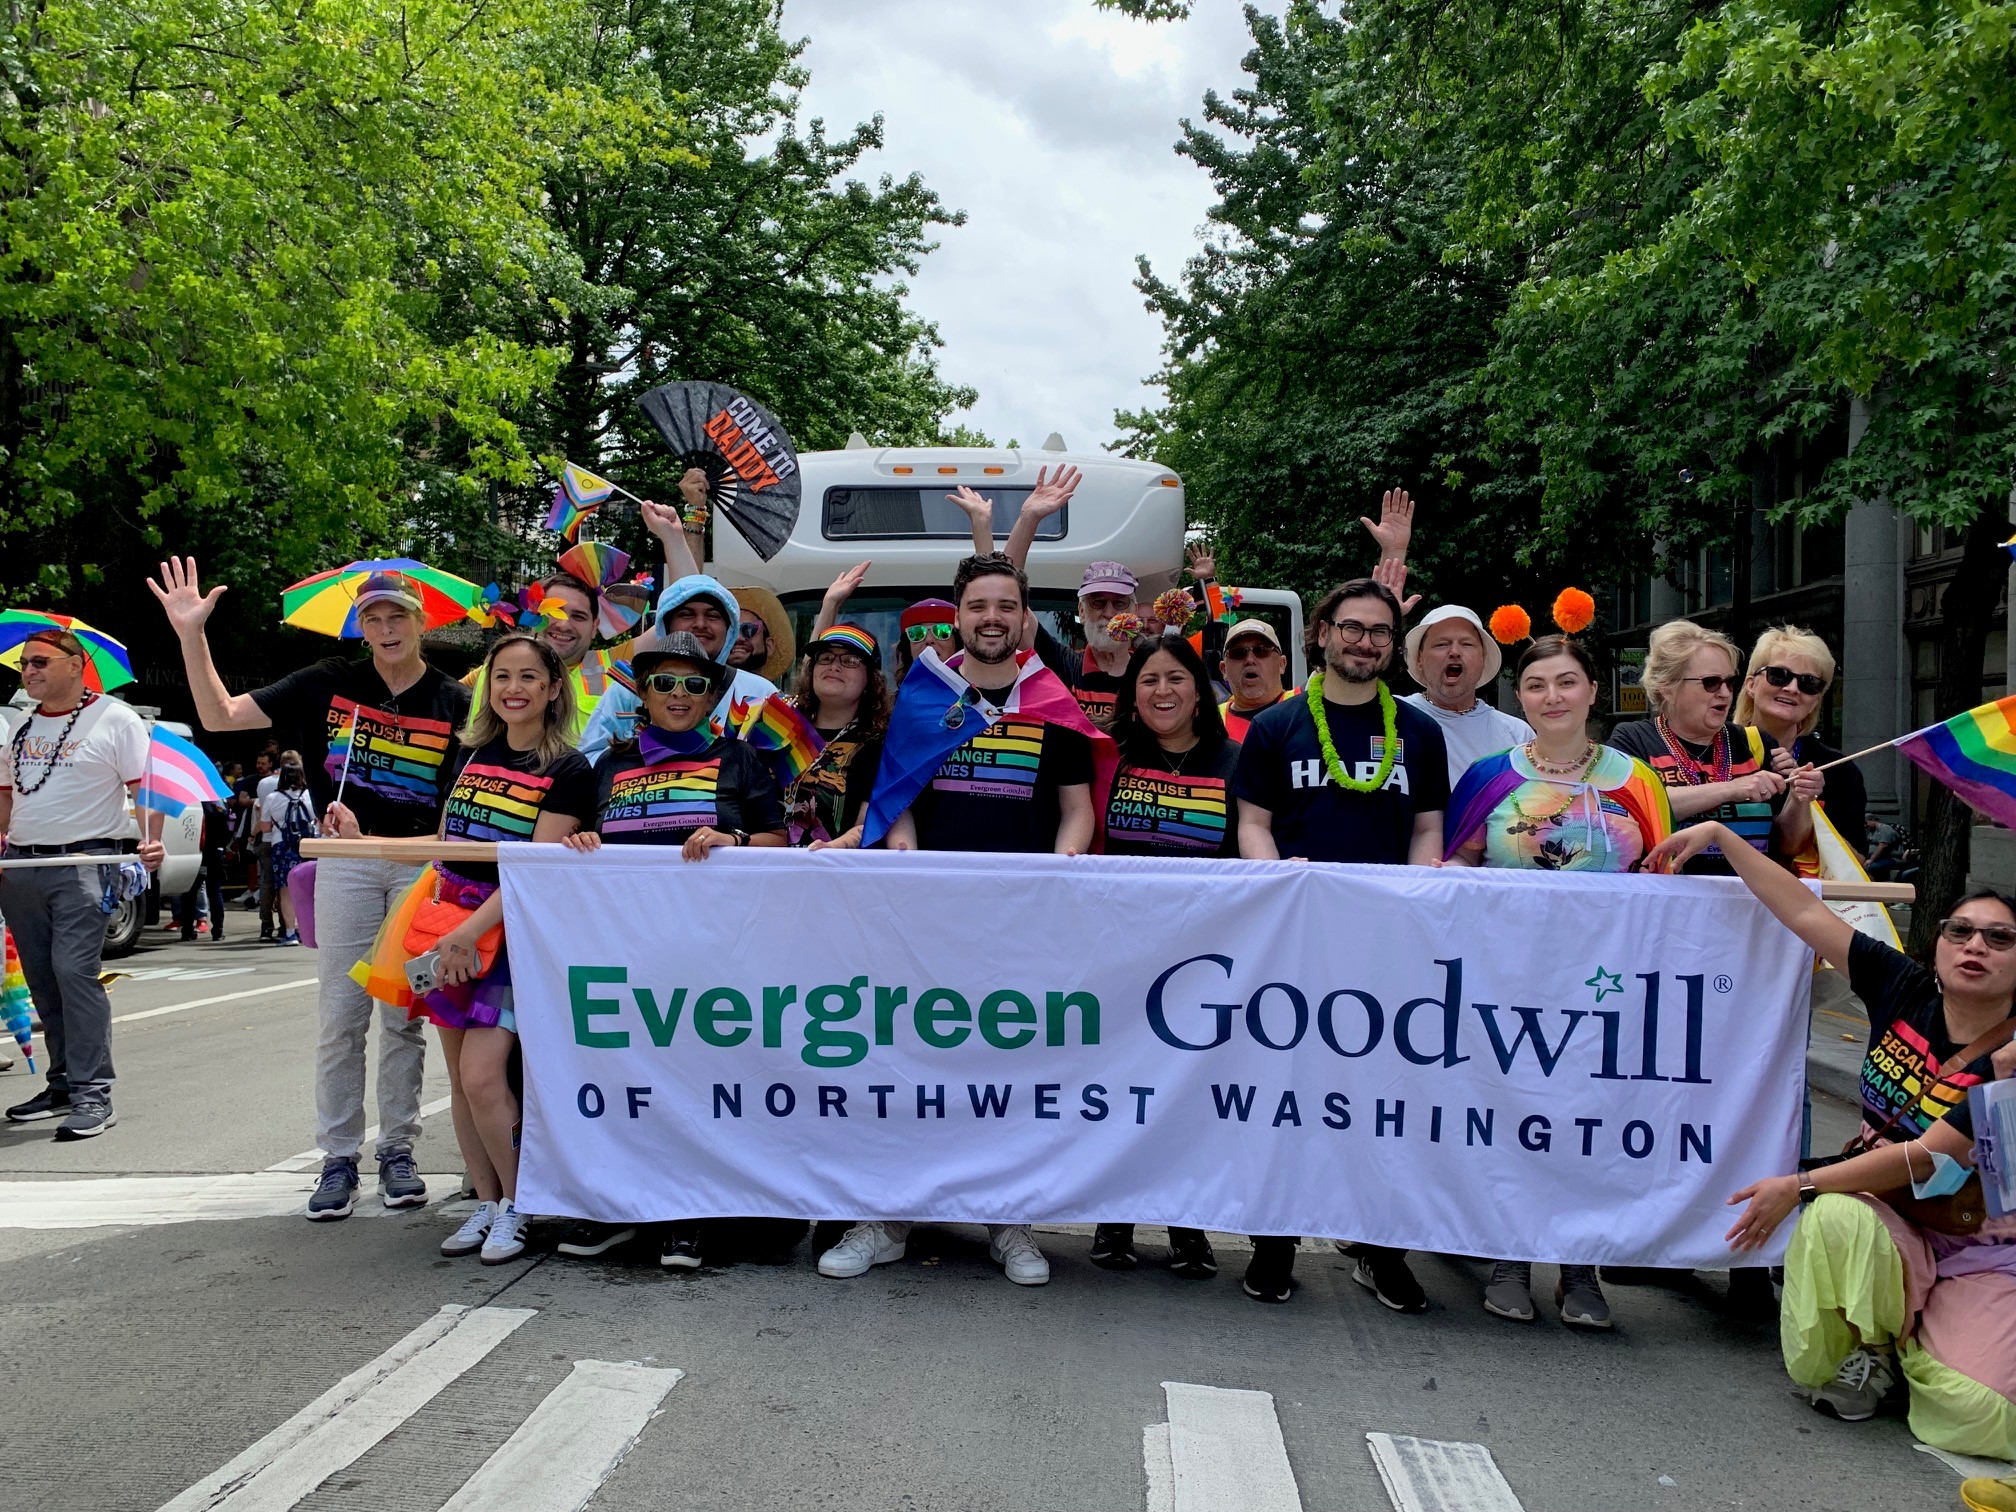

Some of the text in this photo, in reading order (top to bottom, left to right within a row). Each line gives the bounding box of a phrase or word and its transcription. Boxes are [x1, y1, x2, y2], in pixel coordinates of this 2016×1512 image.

[725, 396, 796, 480] COME TO
[703, 408, 780, 494] DADDY
[1623, 692, 1646, 702] 100
[457, 775, 509, 794] ECAUSE
[611, 772, 677, 795] BECAUSE
[1118, 777, 1187, 797] BECAUSE
[609, 789, 666, 809] CHANGE
[1114, 789, 1154, 803] JOBS
[604, 805, 643, 821] LIVES
[1110, 802, 1179, 820] CHANGE
[643, 820, 677, 828] Evergreen
[678, 816, 715, 825] Goodwill
[1107, 813, 1152, 830] LIVES
[568, 965, 1101, 1068] Evergreen
[1146, 953, 1712, 1085] Goodwill
[1870, 1045, 1905, 1080] JOBS
[577, 1083, 1713, 1164] OF NORTHWEST WASHINGTON
